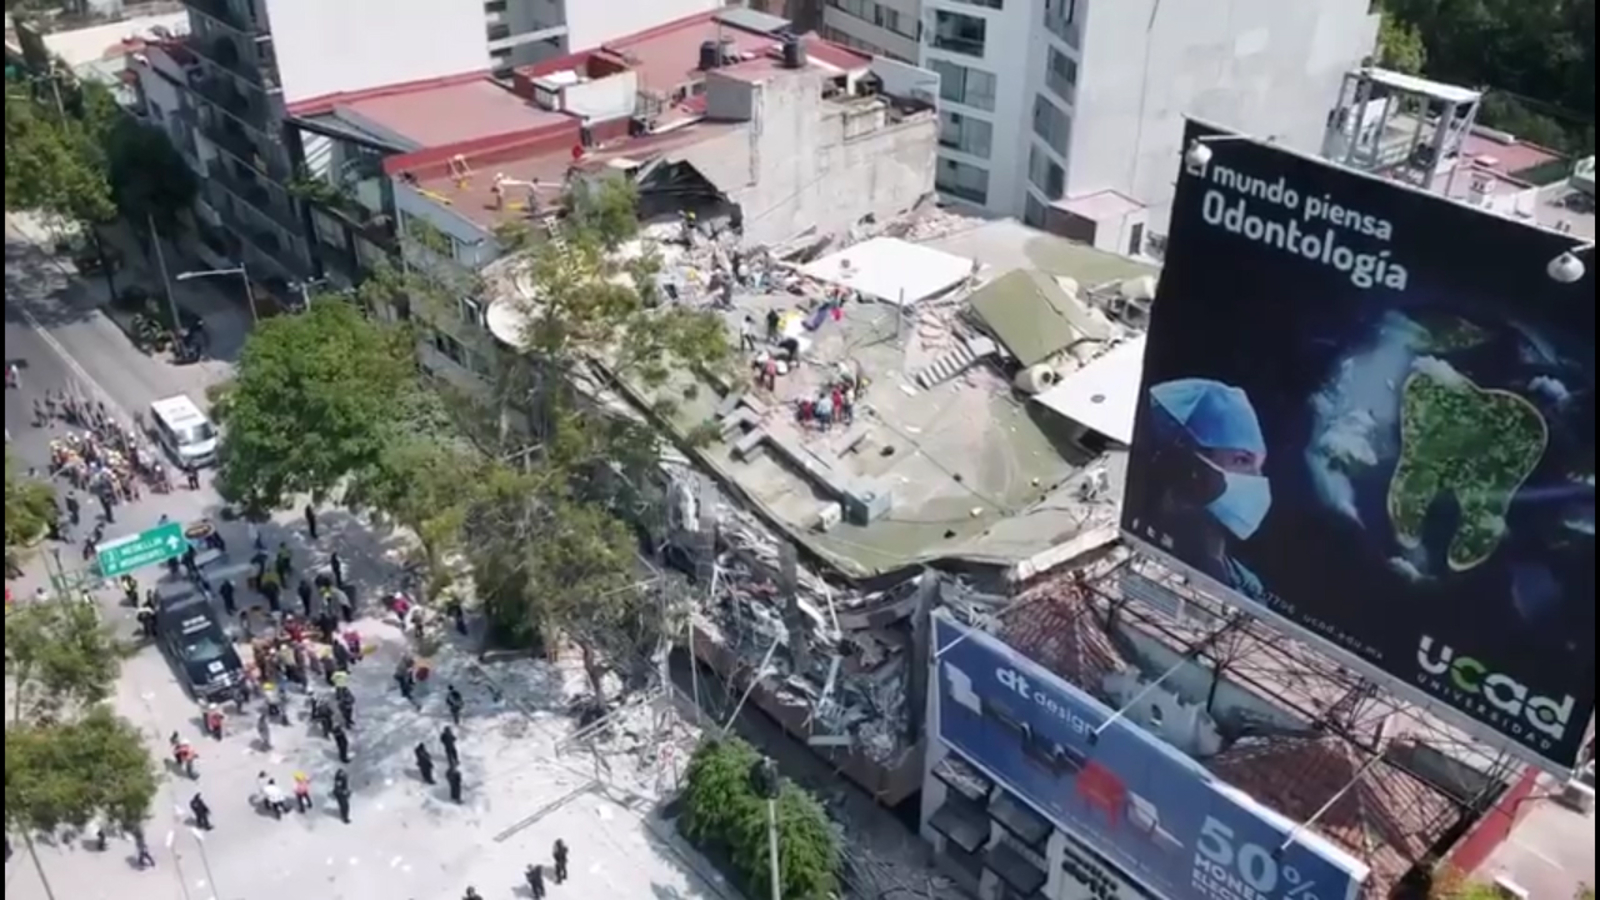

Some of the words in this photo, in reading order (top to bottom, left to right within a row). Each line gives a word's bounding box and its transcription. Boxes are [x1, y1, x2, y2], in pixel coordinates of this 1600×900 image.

[1202, 188, 1409, 291] Odontología
[1213, 165, 1299, 209] mundo
[1304, 195, 1394, 242] piensa
[995, 667, 1031, 700] dt
[1033, 690, 1097, 736] design
[1416, 672, 1552, 751] UNIVERSIDAD
[1417, 634, 1576, 742] ucad
